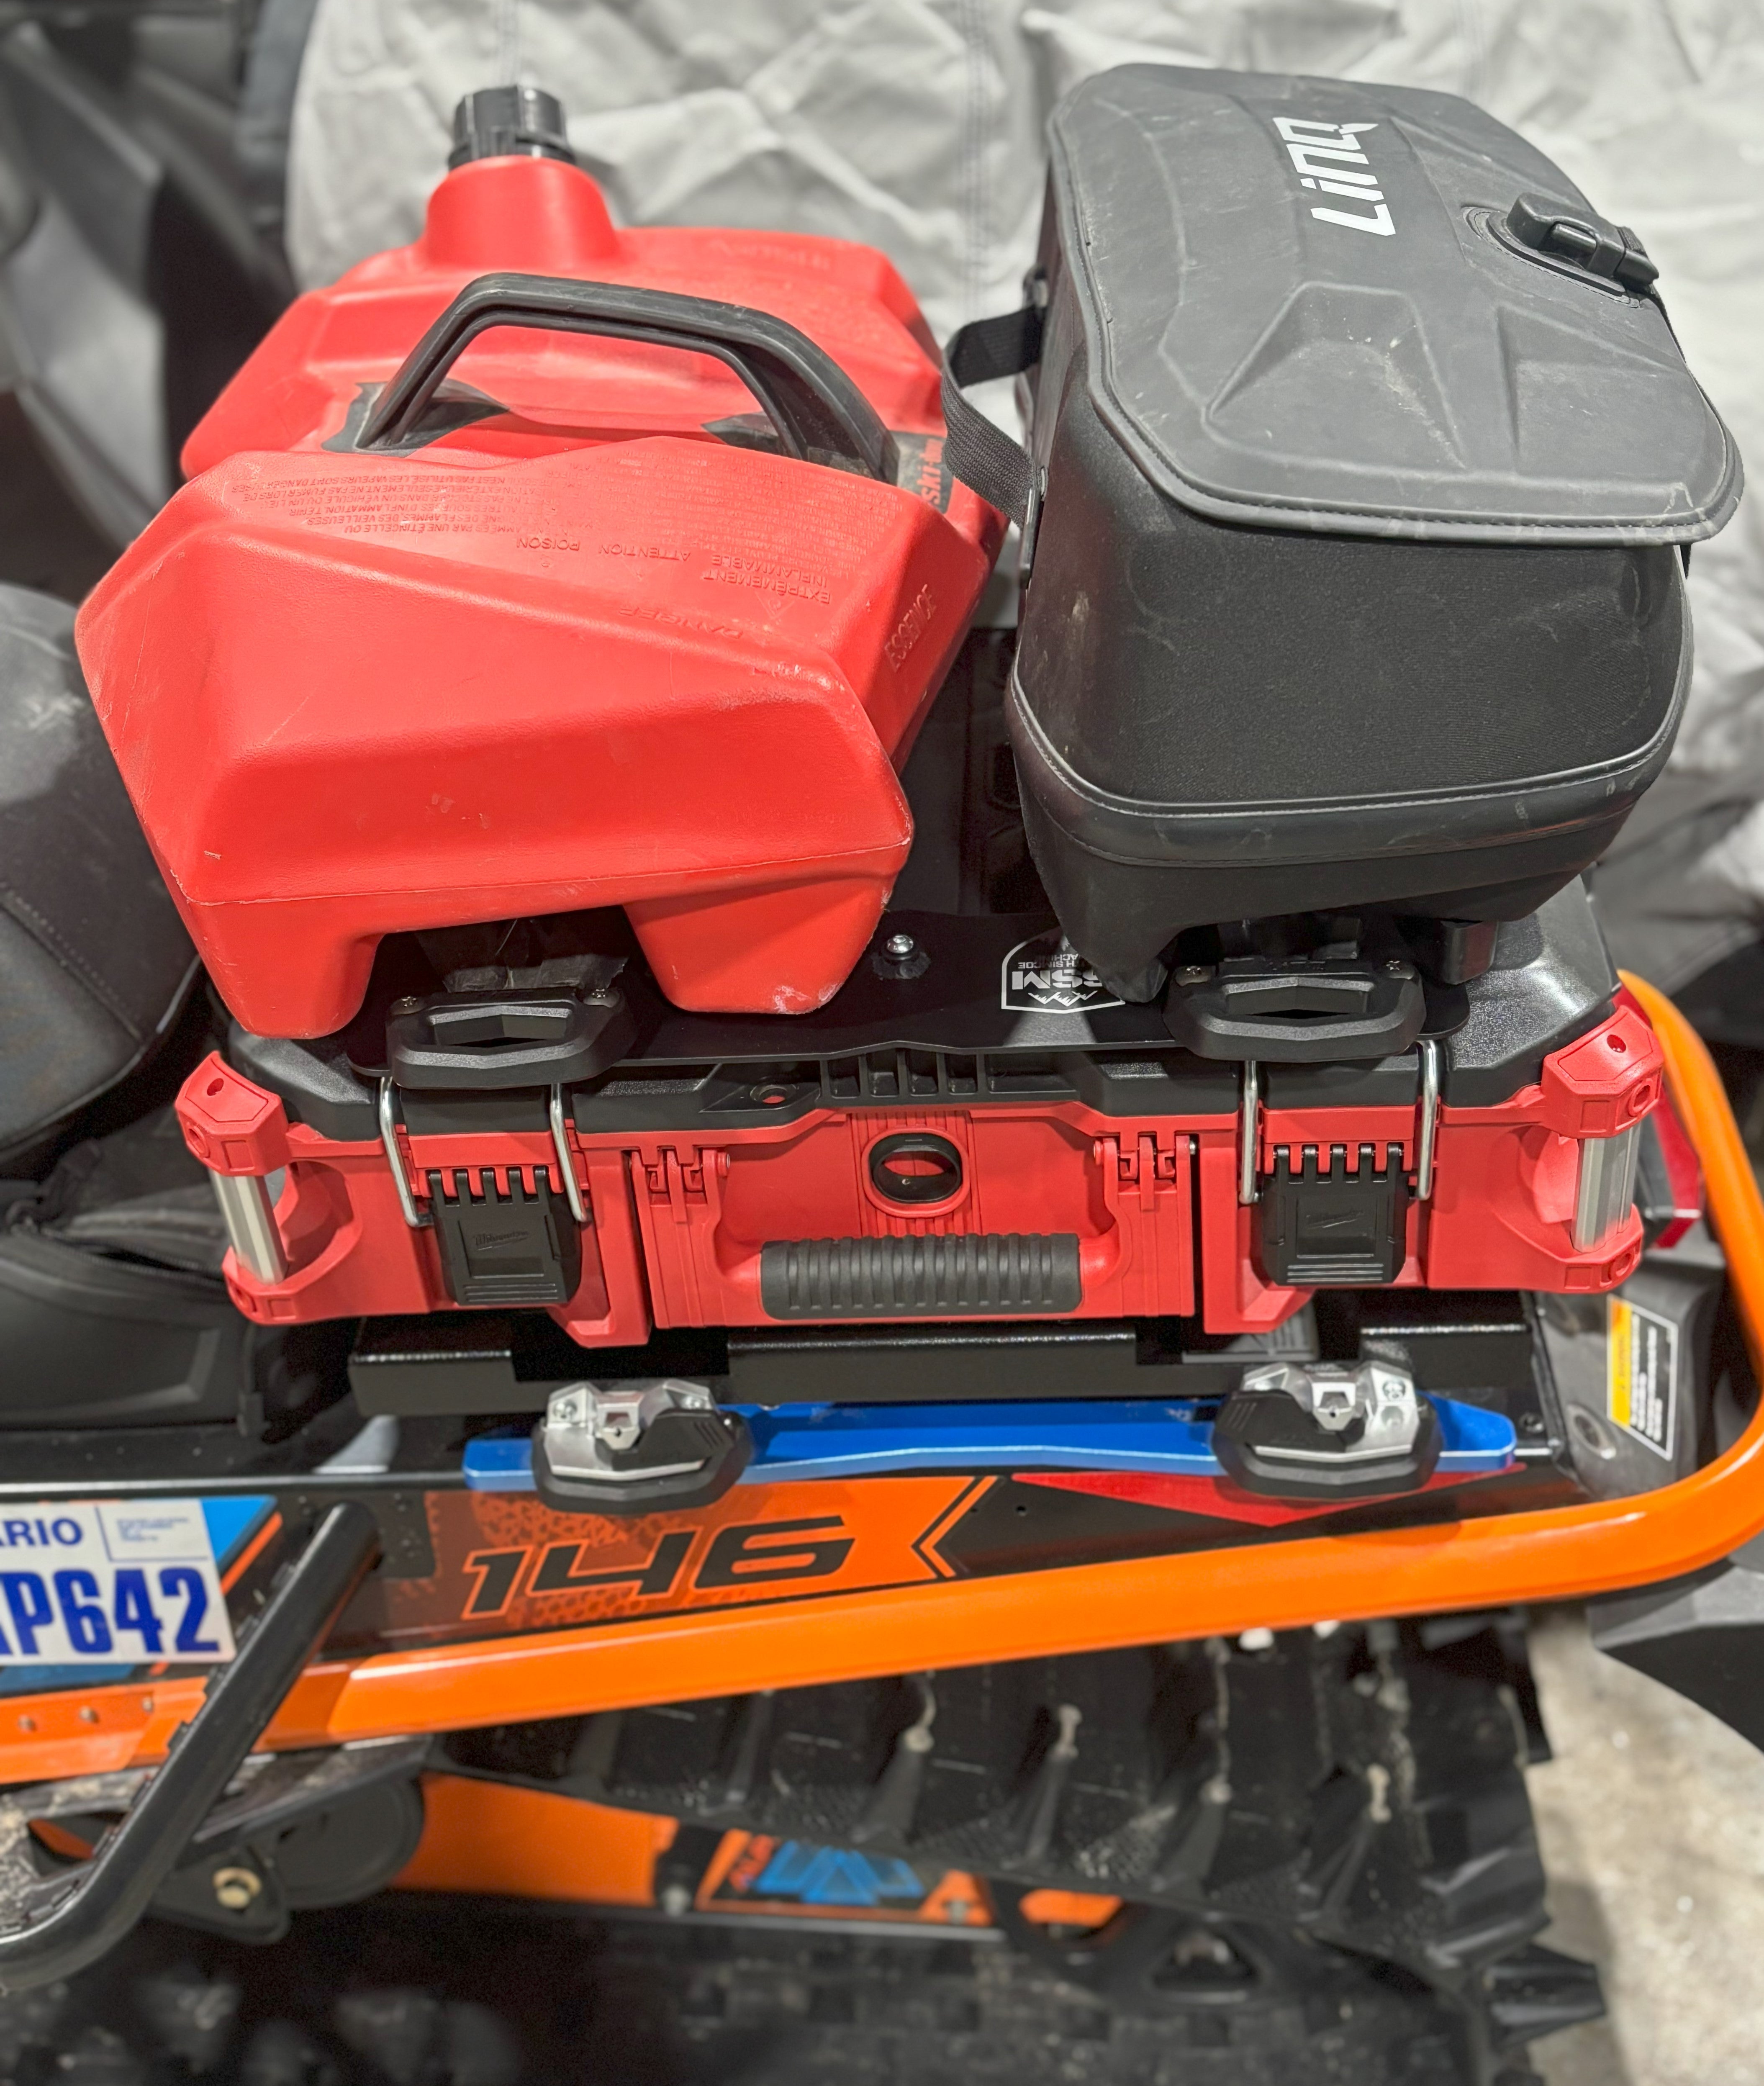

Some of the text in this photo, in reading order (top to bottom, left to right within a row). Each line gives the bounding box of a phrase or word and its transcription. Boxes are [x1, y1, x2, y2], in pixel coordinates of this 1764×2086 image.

[310, 478, 340, 486] SONT
[341, 476, 387, 484] VAPEURS
[242, 493, 258, 502] DE
[258, 491, 287, 500] LORS
[288, 488, 326, 497] FUMER
[289, 507, 321, 516] TENIR
[457, 514, 479, 522] DES
[344, 524, 361, 534] OU
[365, 524, 425, 534] ÉTINCELLE
[427, 524, 449, 532] UNE
[452, 524, 473, 532] PAR
[516, 537, 581, 552] POISON
[598, 543, 691, 562] ATTENTION
[711, 554, 828, 587] INFLAMMABLE
[701, 569, 831, 605] EXTRÊMEMENT
[618, 605, 745, 640] DANGER
[884, 583, 937, 673] ESSENCE
[0, 1518, 83, 1546] RIO
[462, 1515, 855, 1621] 146
[0, 1567, 221, 1656] P642
